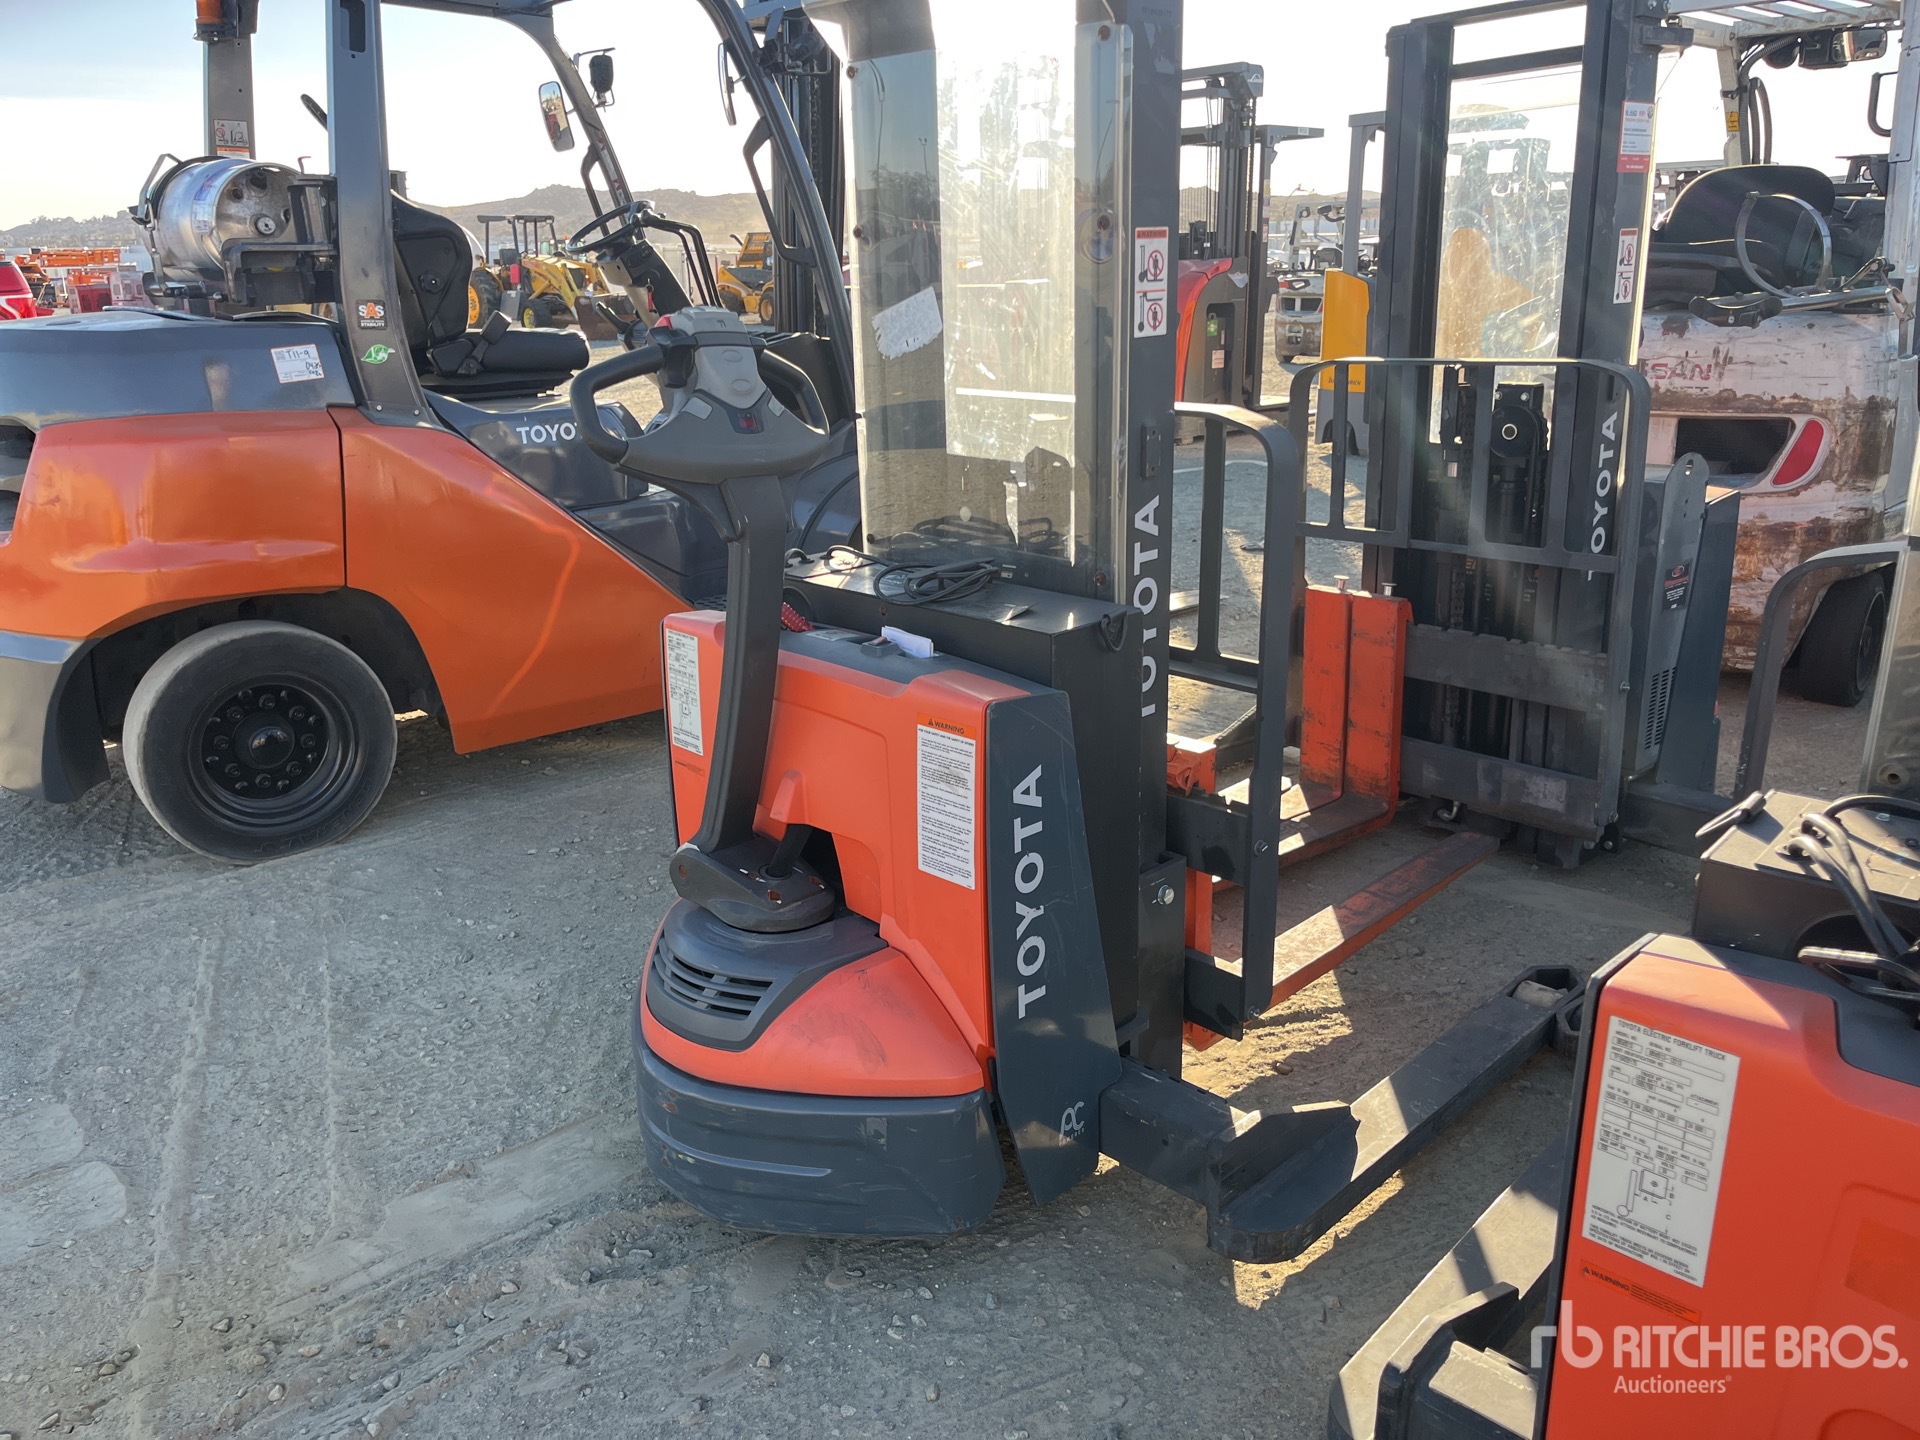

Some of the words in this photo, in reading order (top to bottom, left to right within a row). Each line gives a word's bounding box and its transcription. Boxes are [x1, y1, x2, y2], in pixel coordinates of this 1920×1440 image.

[358, 303, 385, 318] SAS
[1645, 363, 1713, 380] SAN
[516, 422, 577, 444] TOYO
[934, 720, 965, 735] WARNING
[1012, 764, 1047, 1020] TOYOTA
[1617, 1019, 1641, 1033] TOYOTA
[1642, 1028, 1671, 1043] ELECTRIC
[1672, 1037, 1702, 1053] FORKLIFT
[1704, 1048, 1725, 1061] TRUCK
[1591, 1269, 1630, 1292] WARNING
